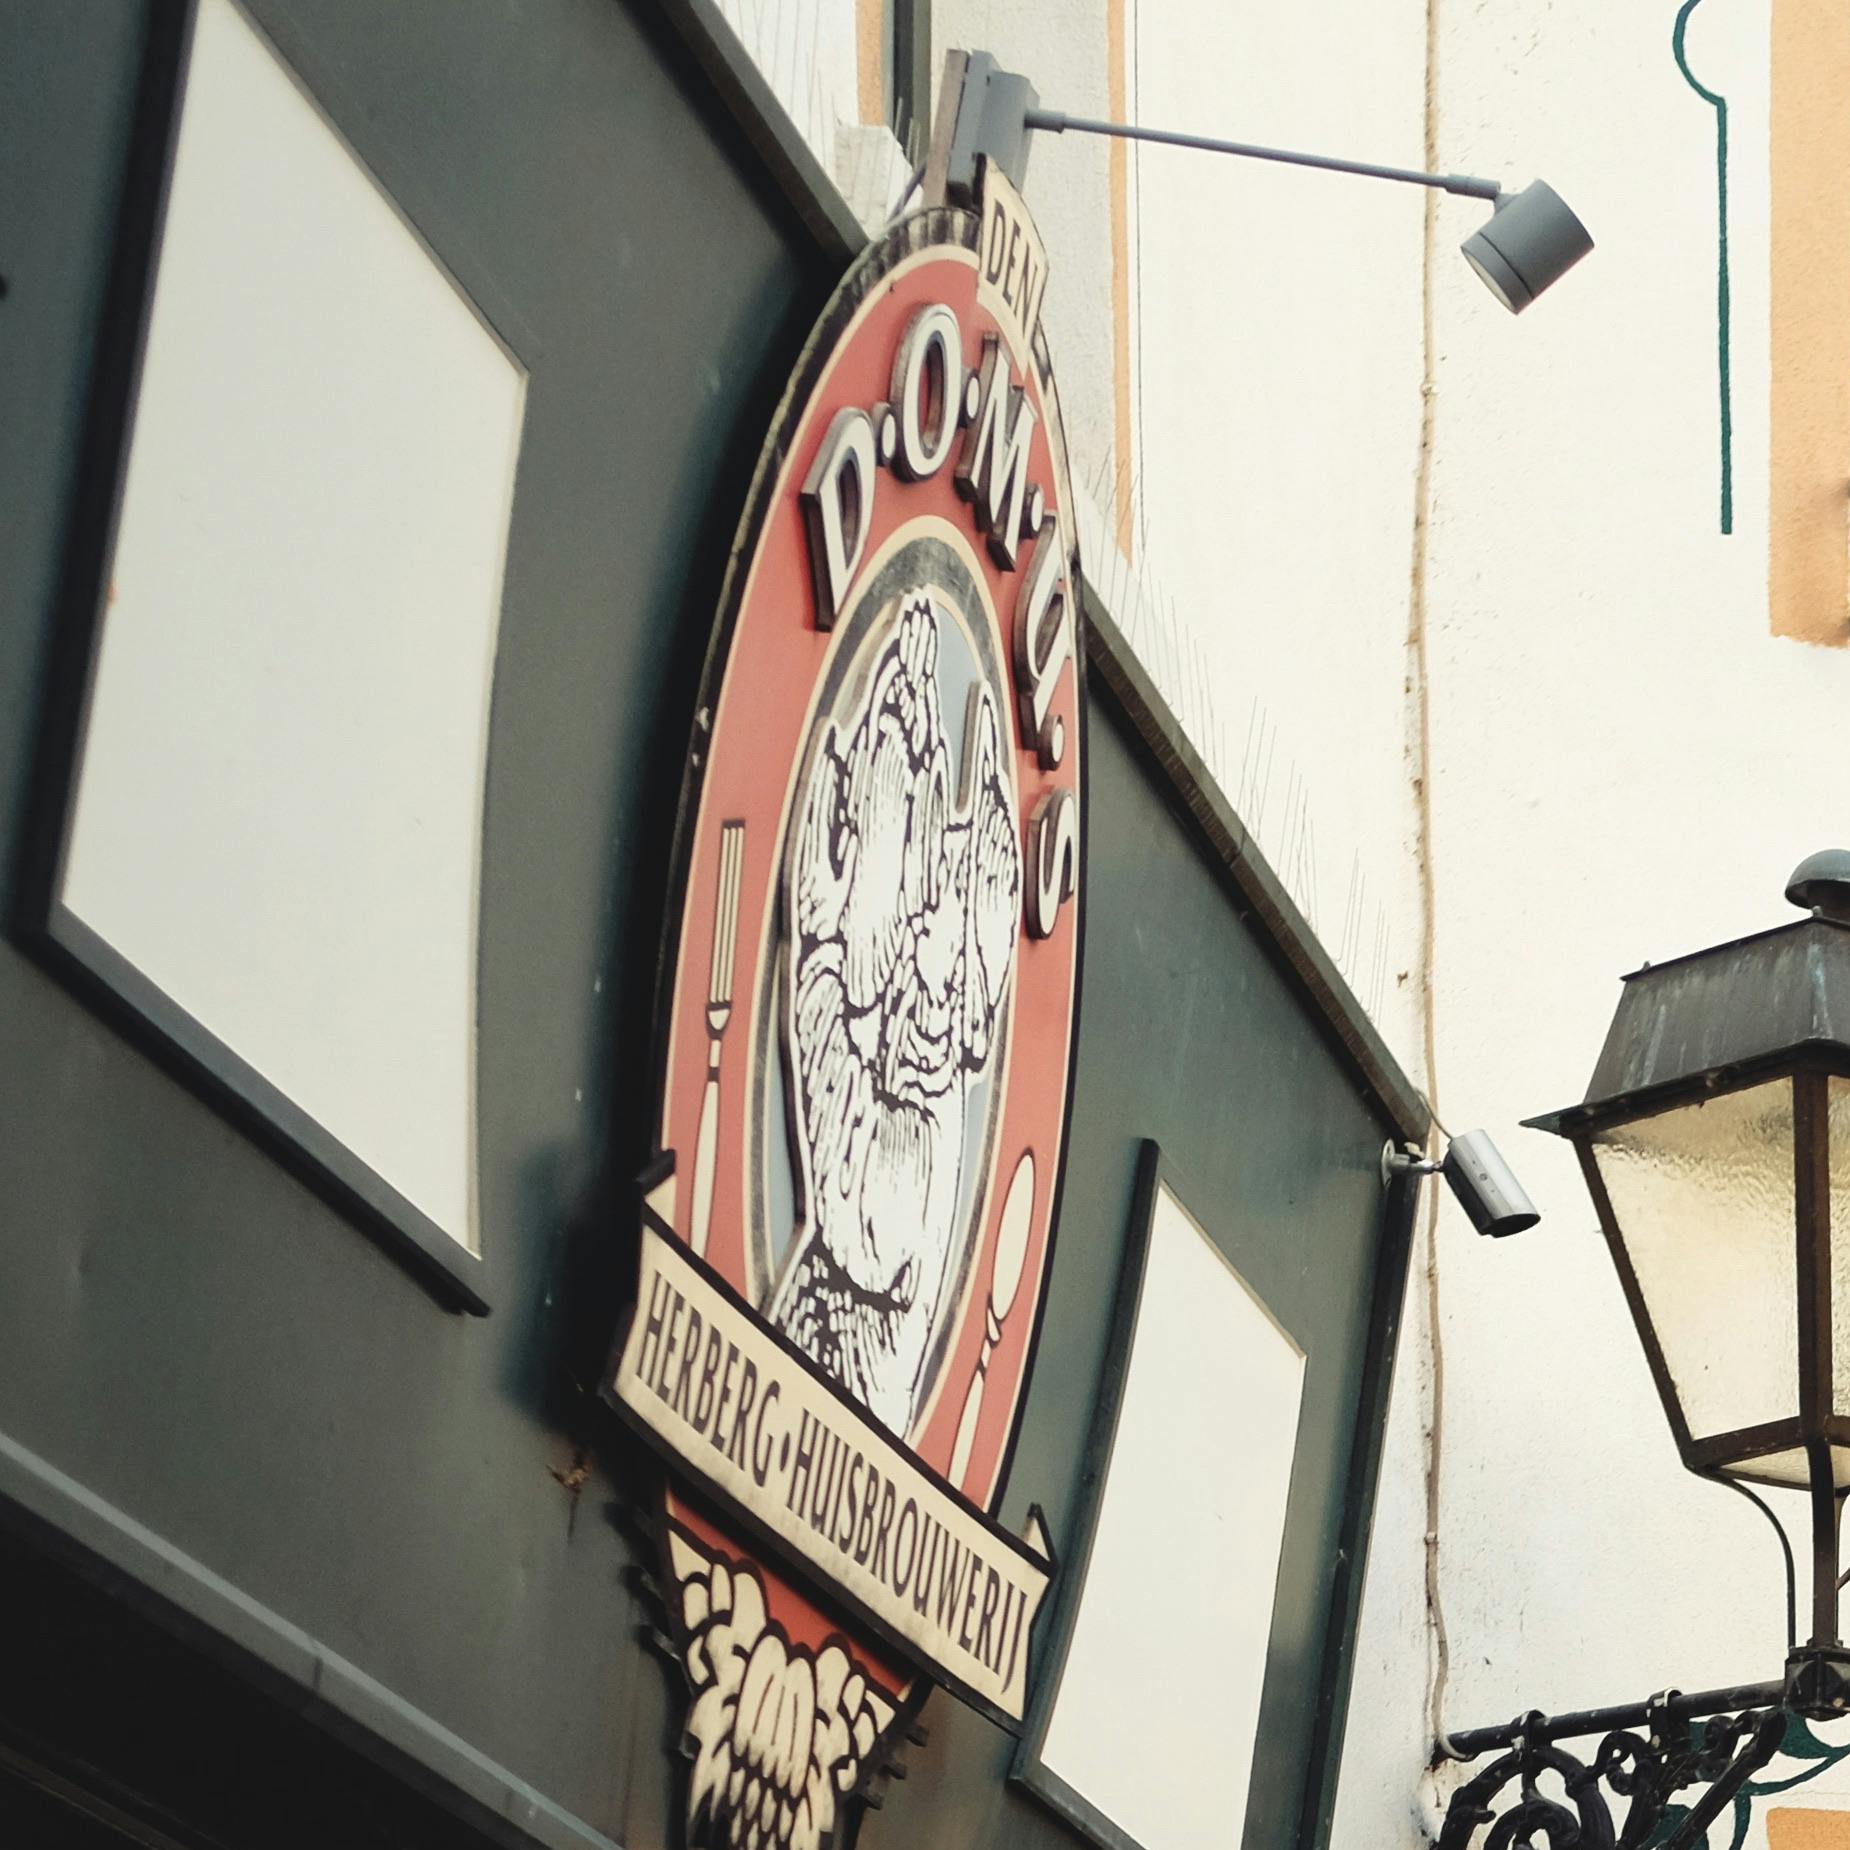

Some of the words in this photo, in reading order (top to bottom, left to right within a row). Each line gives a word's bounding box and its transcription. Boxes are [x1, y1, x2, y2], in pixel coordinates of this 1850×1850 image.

[986, 200, 1040, 338] DEN
[635, 1270, 781, 1488] HERBERG
[786, 1407, 1029, 1695] HUISBROUWERIJ
